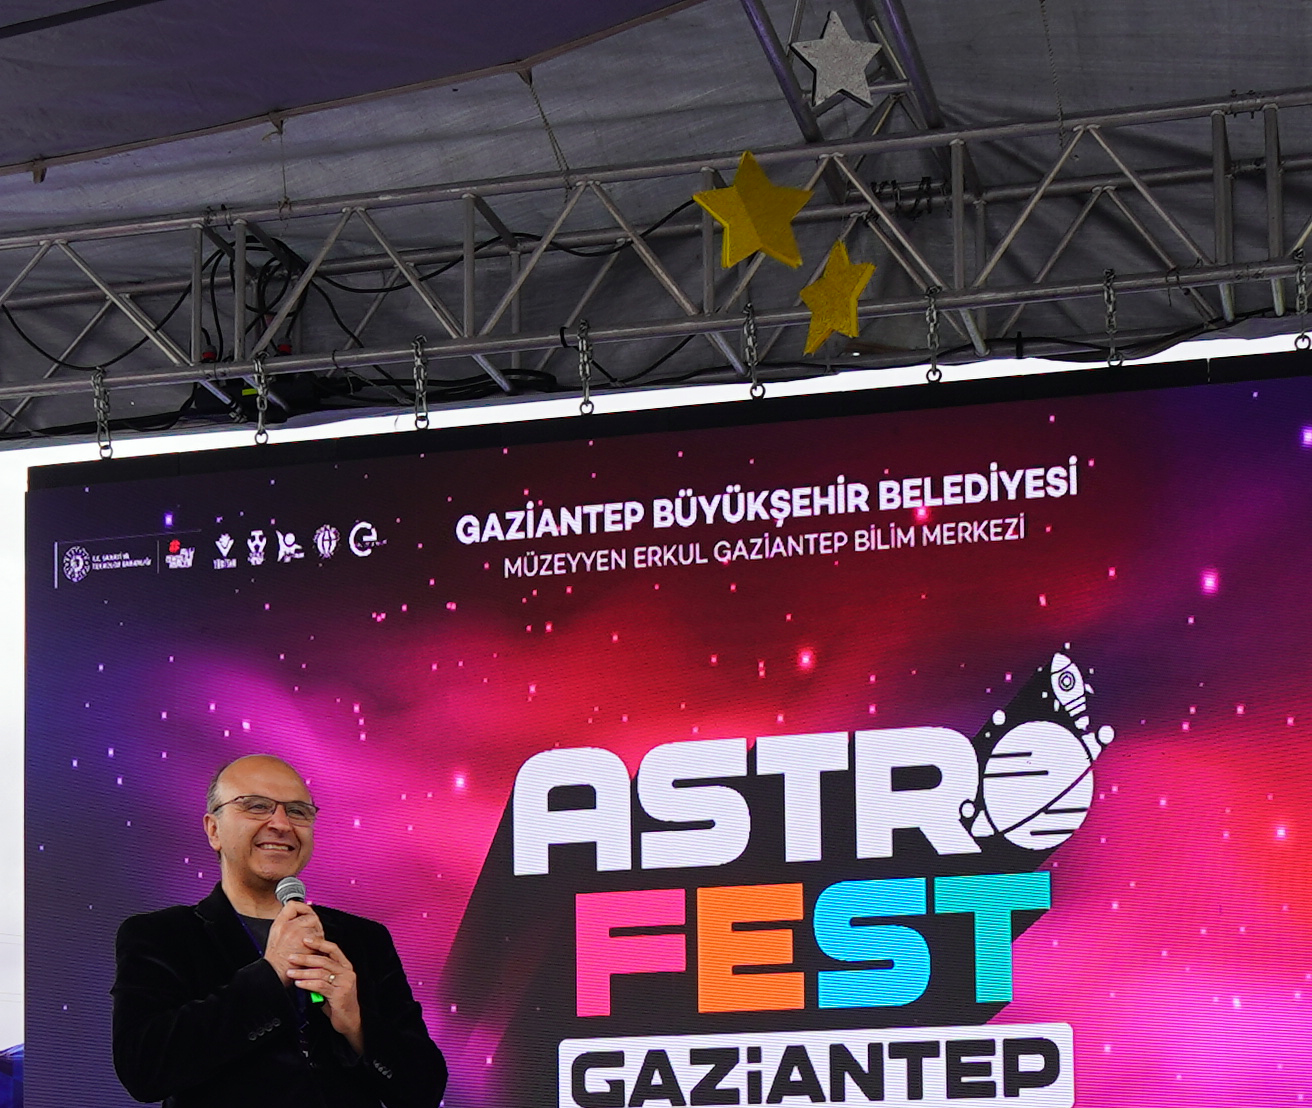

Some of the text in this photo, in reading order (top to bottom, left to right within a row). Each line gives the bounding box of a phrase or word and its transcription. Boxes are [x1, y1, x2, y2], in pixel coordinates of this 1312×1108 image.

[455, 455, 1078, 544] GAZİANTEP BÜYÜKŞEHİR BELEDİYESİ
[504, 513, 1025, 578] MÜZEYYEN ERKUL GAZİANTEP BİLİM MERKEZİ
[513, 721, 1094, 876] ASTRO
[576, 871, 1052, 1017] FEST
